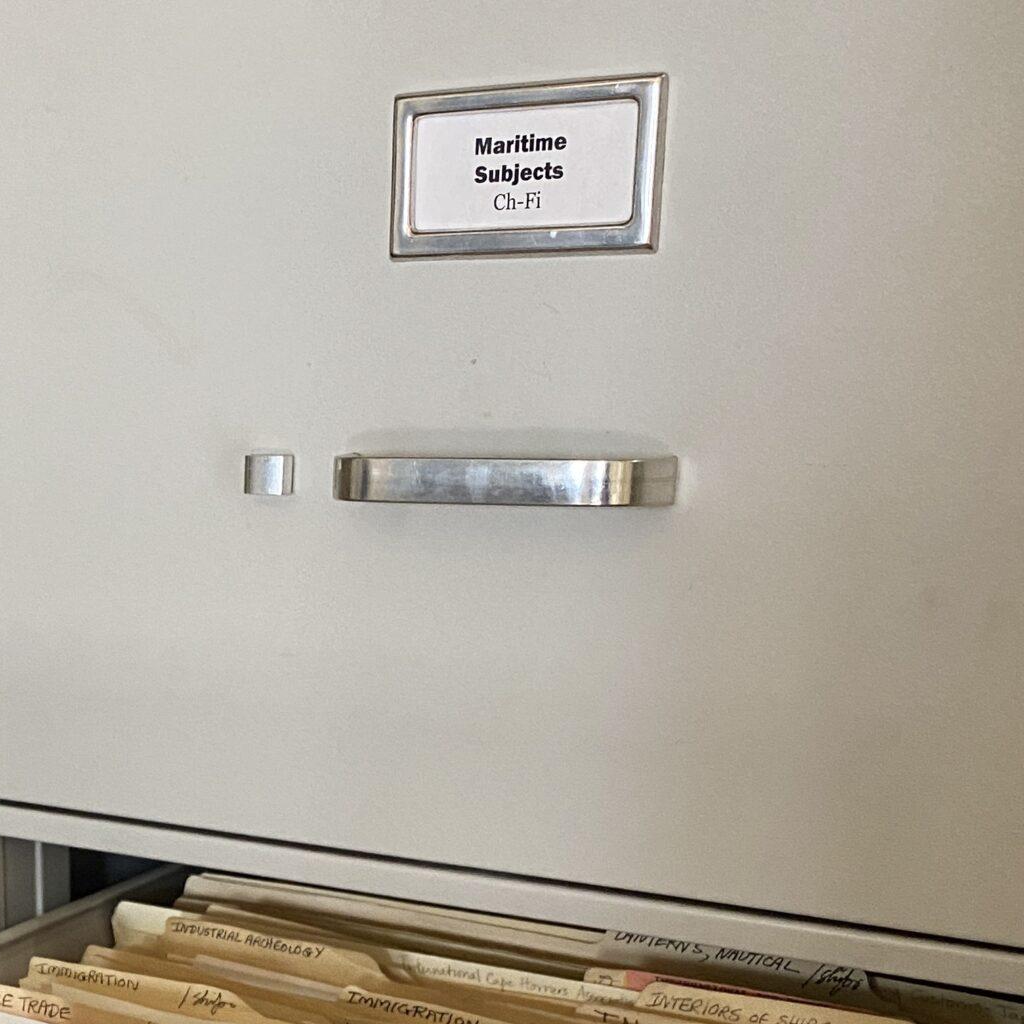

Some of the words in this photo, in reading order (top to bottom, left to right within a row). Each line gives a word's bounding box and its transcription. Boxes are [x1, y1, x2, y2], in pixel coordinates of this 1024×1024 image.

[475, 134, 567, 155] Maritime
[474, 162, 564, 185] Subjects
[493, 191, 542, 210] Ch-Fi
[172, 921, 242, 943] INDUSTRIAL
[243, 934, 326, 958] ARCHEOLOGY
[714, 947, 801, 974] NAUTICAL
[36, 963, 140, 991] IMMIGRATION
[18, 996, 72, 1020] TRADE
[647, 992, 742, 1022] INTERIORS
